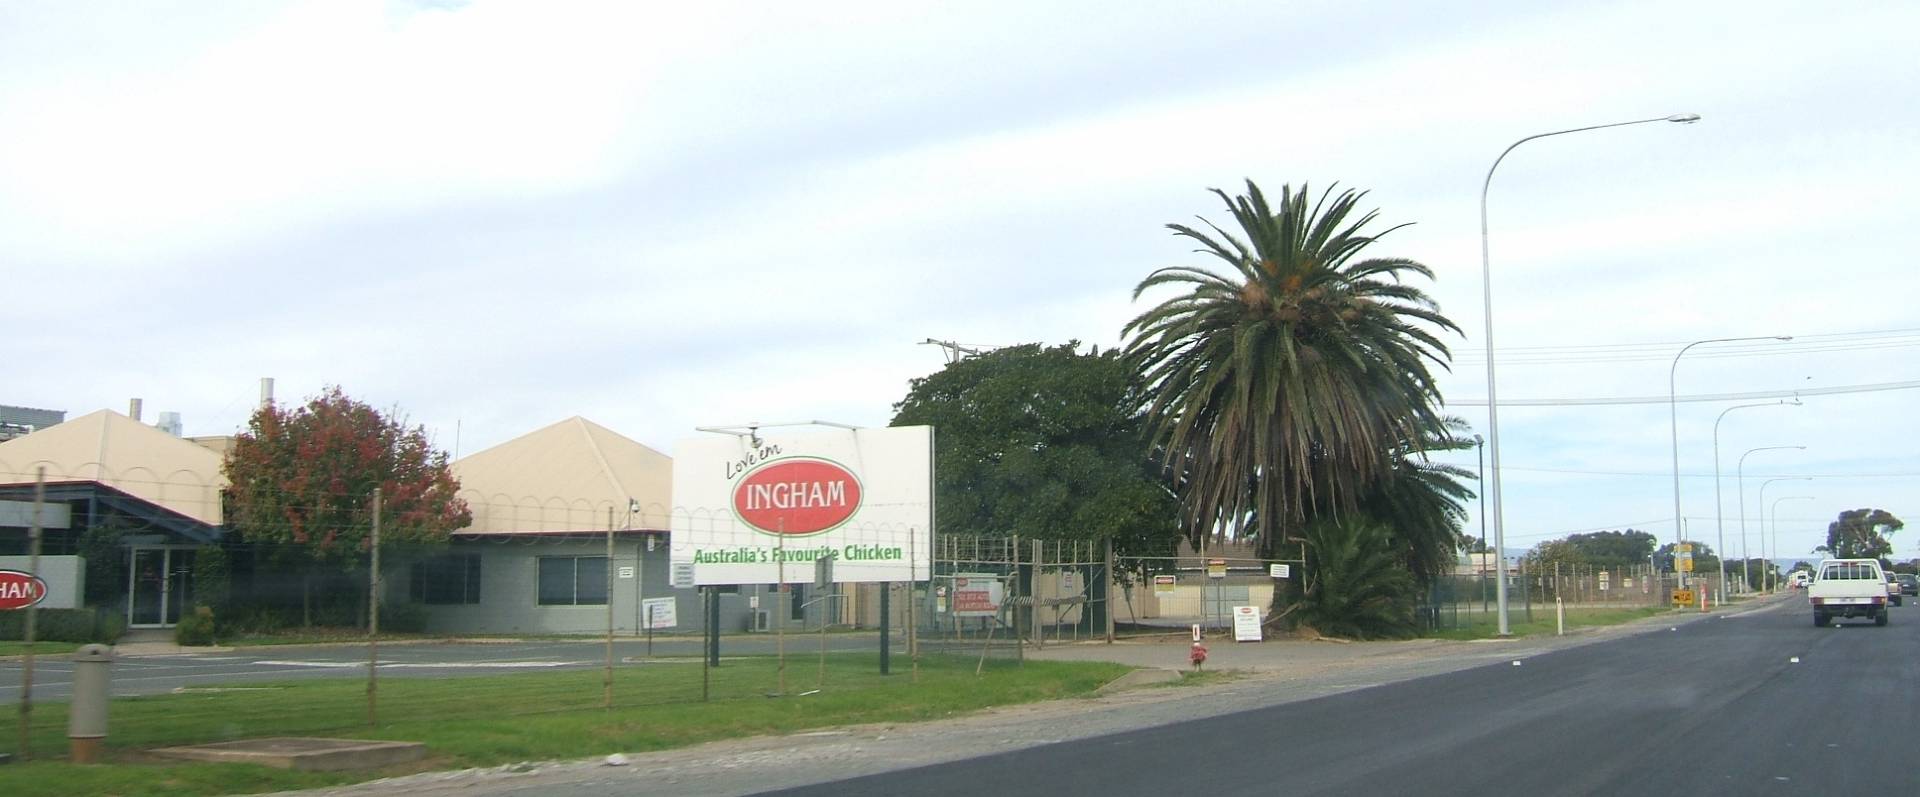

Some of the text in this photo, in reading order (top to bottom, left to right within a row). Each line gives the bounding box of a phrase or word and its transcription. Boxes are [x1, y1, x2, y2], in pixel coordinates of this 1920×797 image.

[726, 451, 757, 480] Love
[746, 480, 846, 510] INGHAM
[694, 544, 901, 564] Australia's Favourite Chicken
